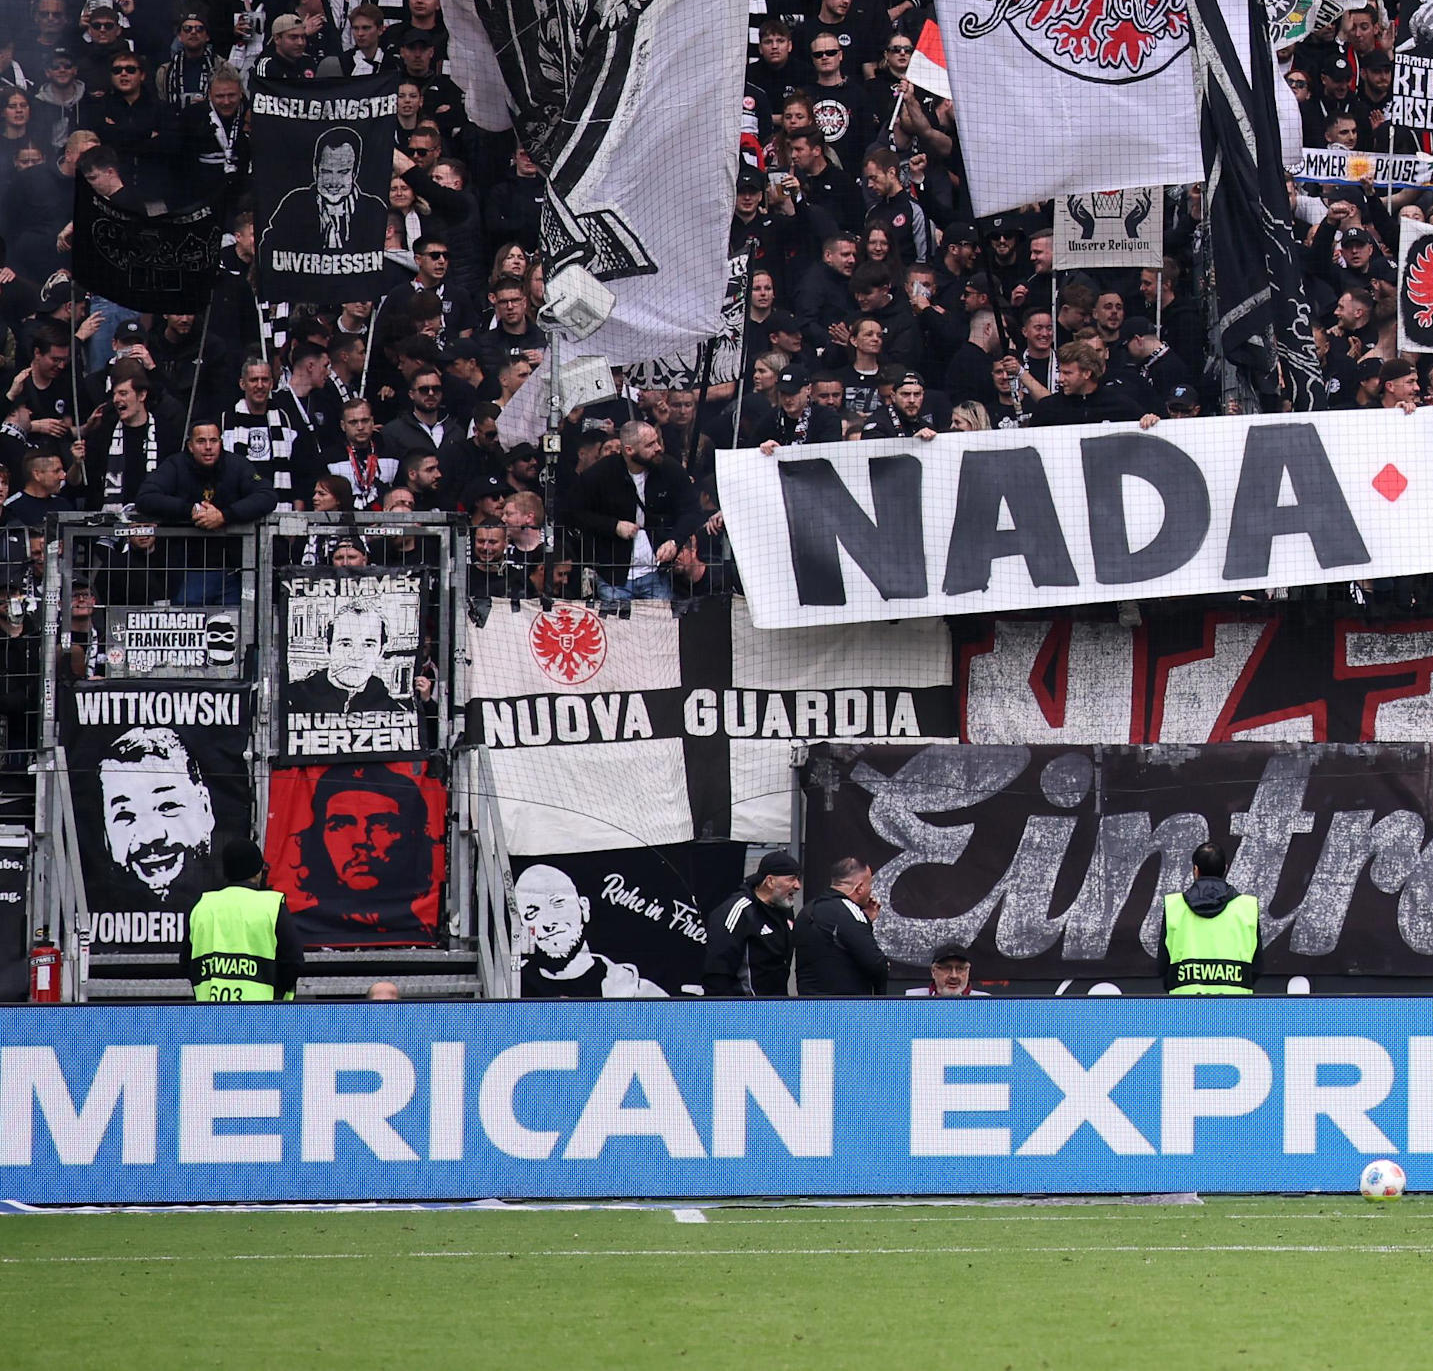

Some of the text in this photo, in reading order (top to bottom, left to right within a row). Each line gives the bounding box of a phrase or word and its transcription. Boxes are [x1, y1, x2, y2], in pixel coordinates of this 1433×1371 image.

[252, 91, 399, 121] GEISELGANGSTER
[1068, 238, 1150, 253] Unsere Religion
[272, 249, 383, 275] UNVERGESSEN
[778, 422, 1372, 602] NADA
[339, 576, 421, 596] IMMER
[127, 611, 206, 630] EINTRACHT
[127, 630, 206, 648] FRANKFURT
[127, 648, 206, 667] HOOLIGANS
[76, 691, 241, 726] WITTKOWSKI
[288, 710, 419, 730] IN UNSEREN
[482, 687, 919, 749] NUOVA GUARDIA
[288, 727, 420, 756] HERZEN!
[604, 873, 646, 913] Ruhe
[646, 899, 664, 921] in
[1177, 960, 1243, 985] STEWARD
